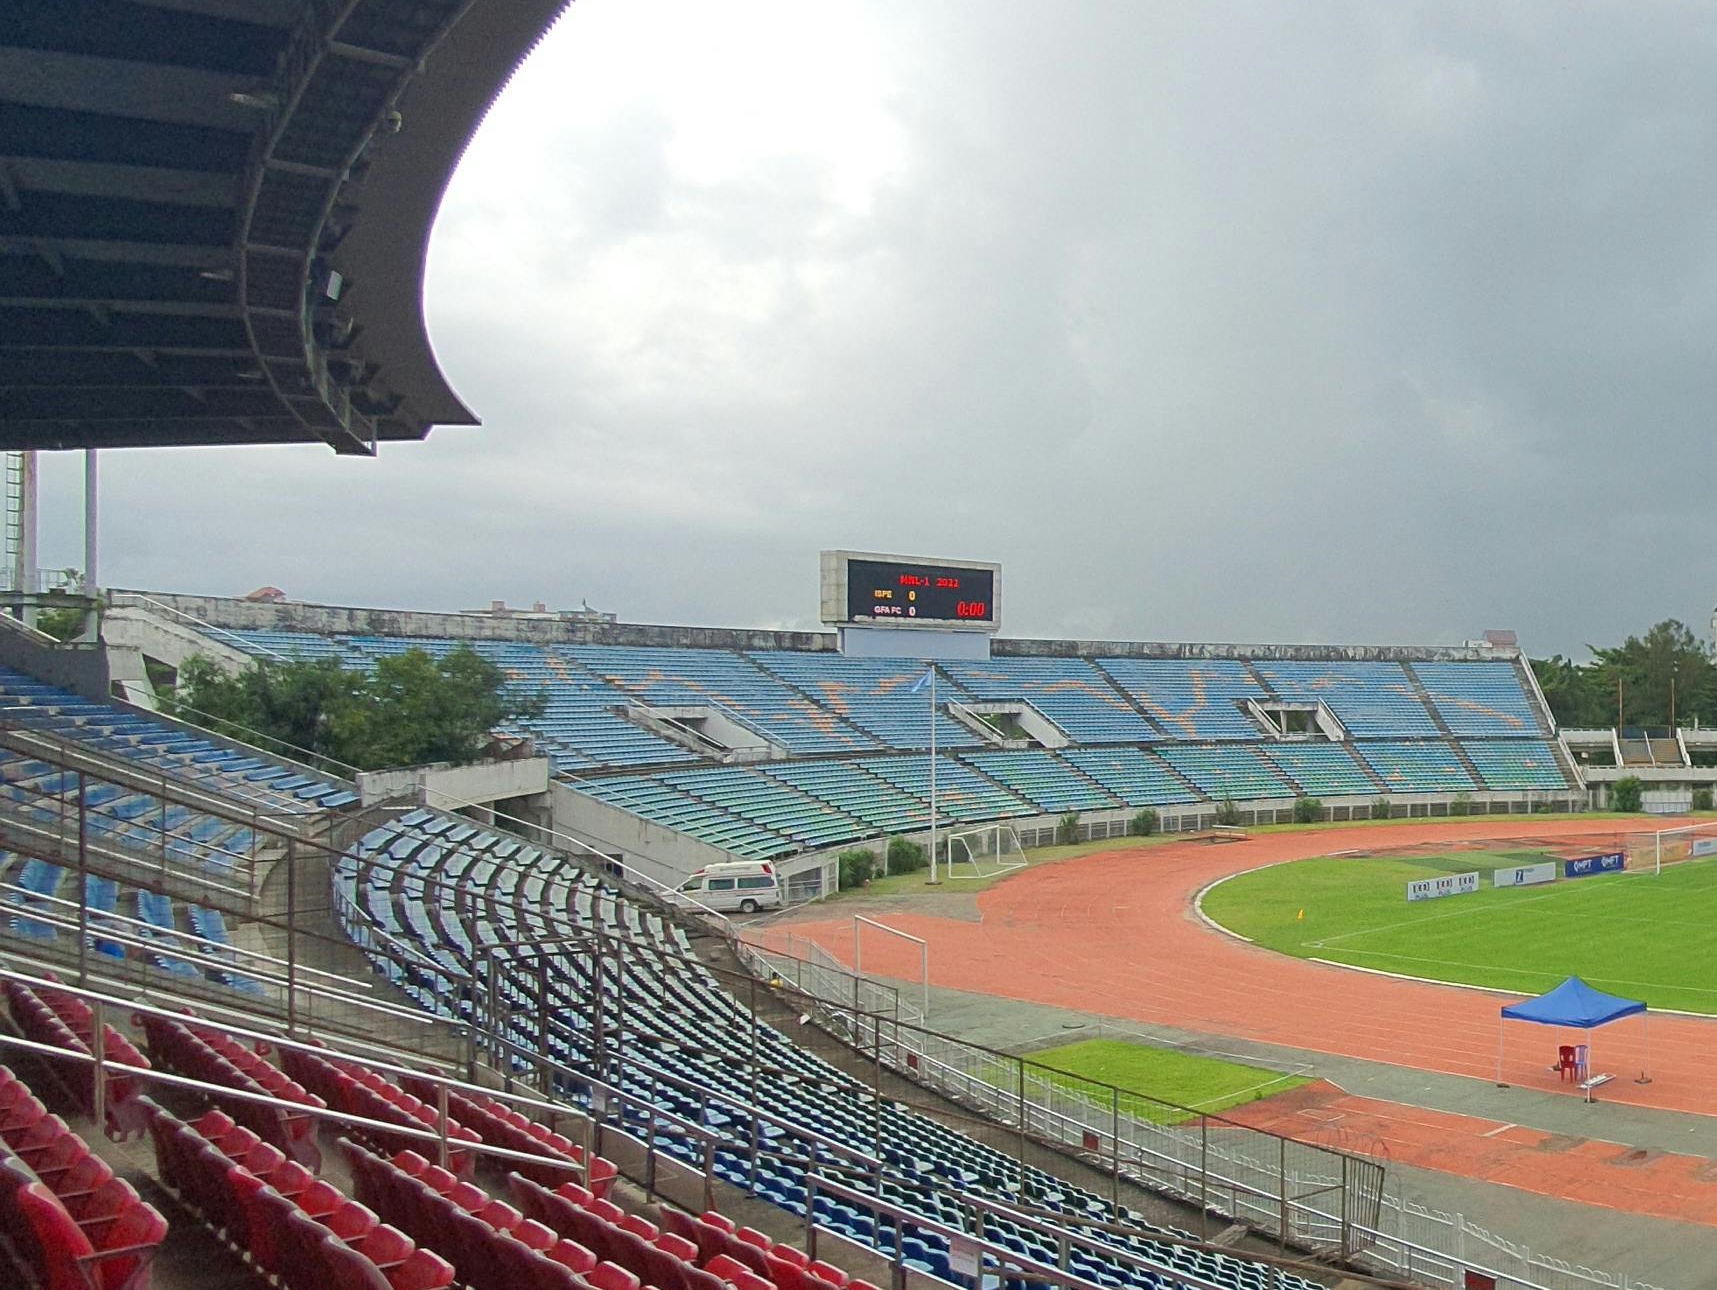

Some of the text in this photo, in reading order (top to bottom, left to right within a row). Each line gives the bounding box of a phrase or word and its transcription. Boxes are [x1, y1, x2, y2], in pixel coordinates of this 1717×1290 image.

[874, 590, 916, 601] ISPE 0
[891, 606, 902, 615] FC
[909, 607, 916, 616] 0
[956, 601, 985, 617] 0:00
